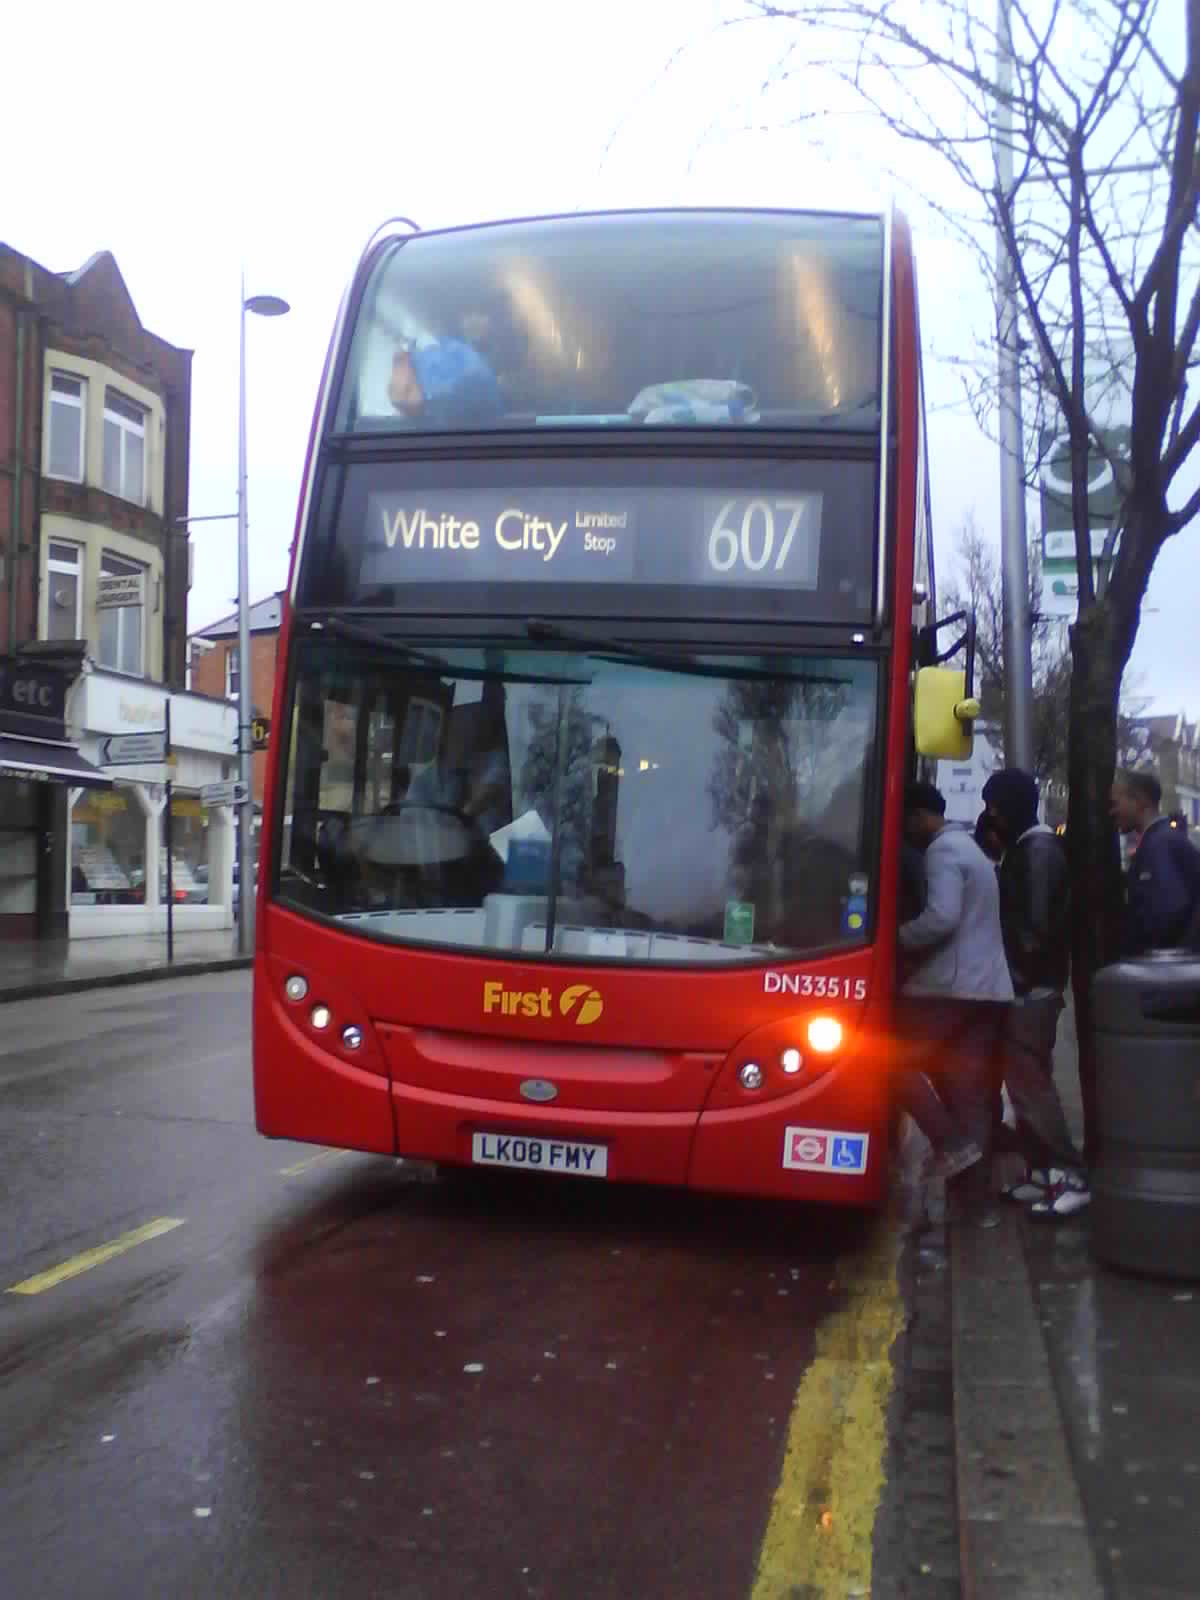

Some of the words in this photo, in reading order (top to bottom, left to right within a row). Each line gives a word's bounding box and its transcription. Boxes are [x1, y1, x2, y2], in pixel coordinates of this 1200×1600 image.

[382, 509, 480, 549] White
[495, 508, 568, 561] City
[575, 511, 627, 528] Limited
[708, 499, 806, 571] 607
[584, 532, 616, 555] Stop
[484, 981, 552, 1017] First
[764, 971, 866, 1000] DN33515
[481, 1136, 542, 1164] LK08
[549, 1143, 596, 1169] FMY
